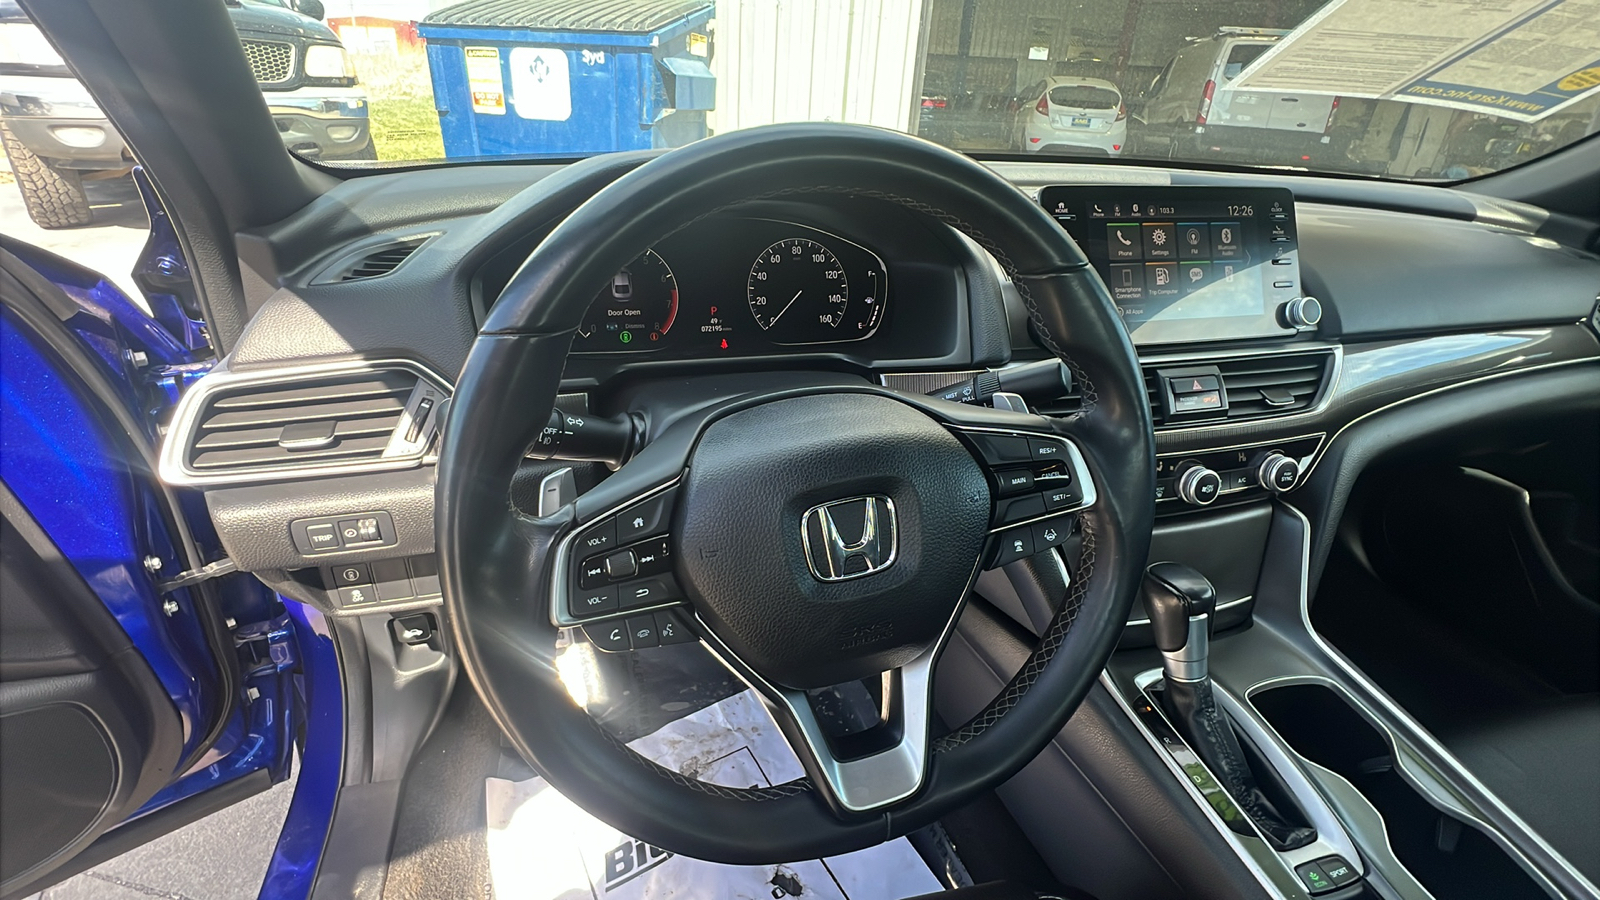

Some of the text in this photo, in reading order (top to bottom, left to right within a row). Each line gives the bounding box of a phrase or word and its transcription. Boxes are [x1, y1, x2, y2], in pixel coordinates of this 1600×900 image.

[1227, 205, 1254, 216] 12:26
[791, 246, 802, 255] 80
[1151, 249, 1170, 257] Settings
[770, 254, 781, 263] 60
[812, 254, 825, 263] 100
[661, 274, 667, 283] 6
[757, 272, 767, 281] 40
[825, 270, 838, 279] 120
[1114, 286, 1142, 294] Smartphone
[756, 296, 767, 305] 20
[828, 294, 841, 303] 140
[667, 300, 672, 309] 7
[624, 308, 641, 316] Open
[710, 306, 718, 316] P
[819, 314, 832, 323] 160
[654, 322, 660, 330] 8
[858, 322, 863, 330] E
[543, 427, 558, 435] OFF
[1011, 477, 1027, 485] MAIN
[312, 534, 334, 542] TRIP
[1193, 775, 1202, 783] D
[1329, 866, 1349, 878] SPORT
